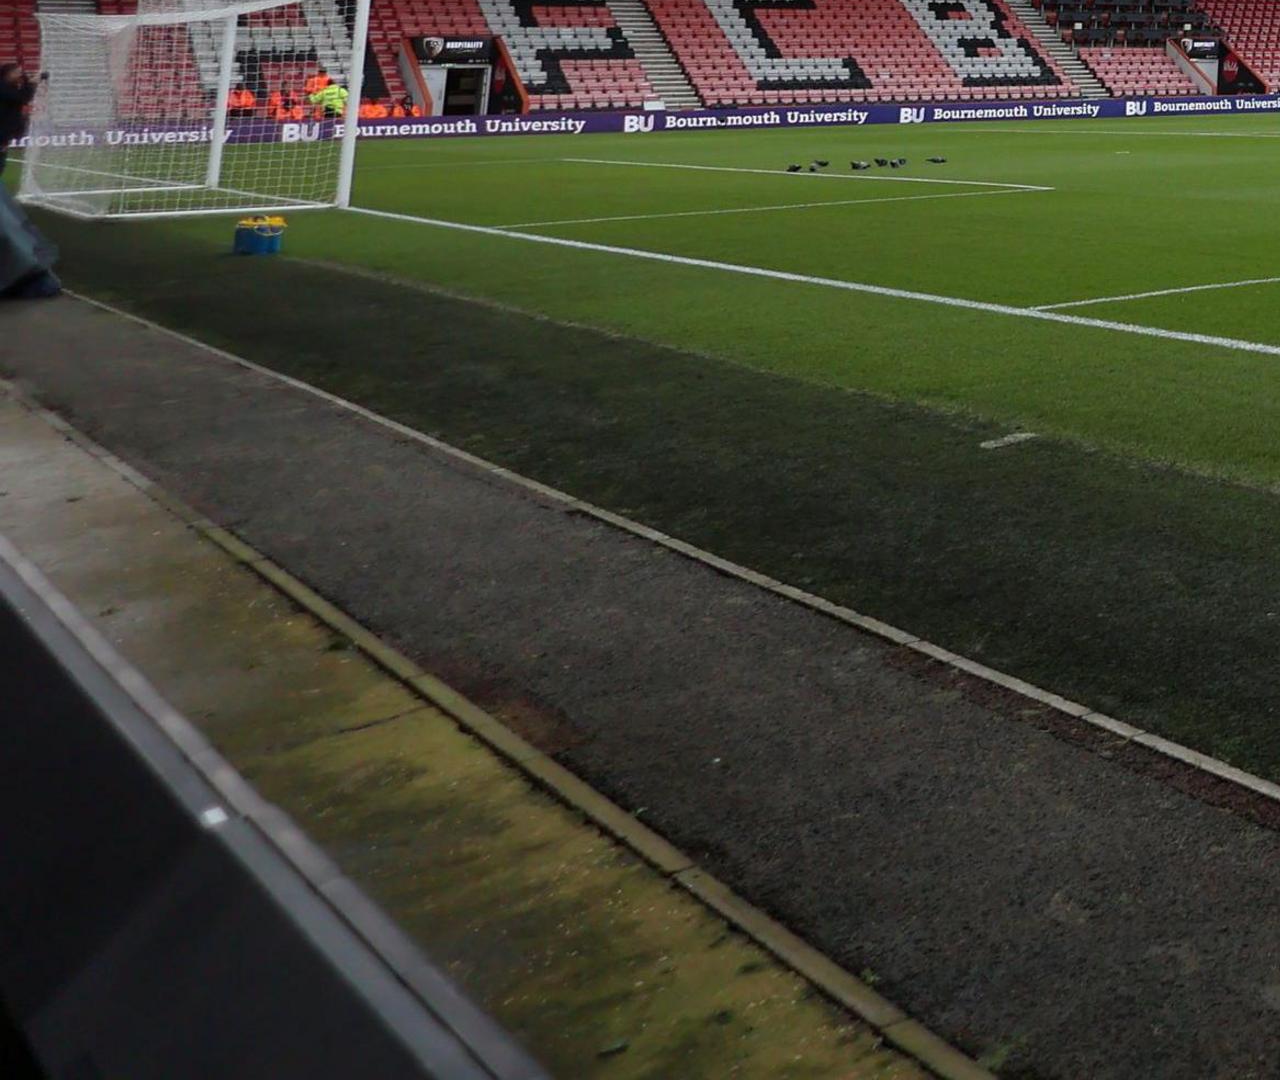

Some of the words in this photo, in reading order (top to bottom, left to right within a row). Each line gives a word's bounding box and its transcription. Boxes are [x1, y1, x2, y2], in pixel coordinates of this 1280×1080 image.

[900, 107, 925, 123] BU
[933, 105, 1028, 120] Bournemouth
[1033, 103, 1099, 117] University
[1126, 100, 1146, 116] BU
[1153, 99, 1231, 113] Bournemouth
[282, 123, 320, 142] BU
[334, 120, 477, 138] Burnemouth
[486, 118, 586, 134] University
[624, 115, 654, 133] BU
[664, 111, 780, 129] Bournmouth
[787, 108, 868, 124] University
[106, 129, 233, 145] Universiy
